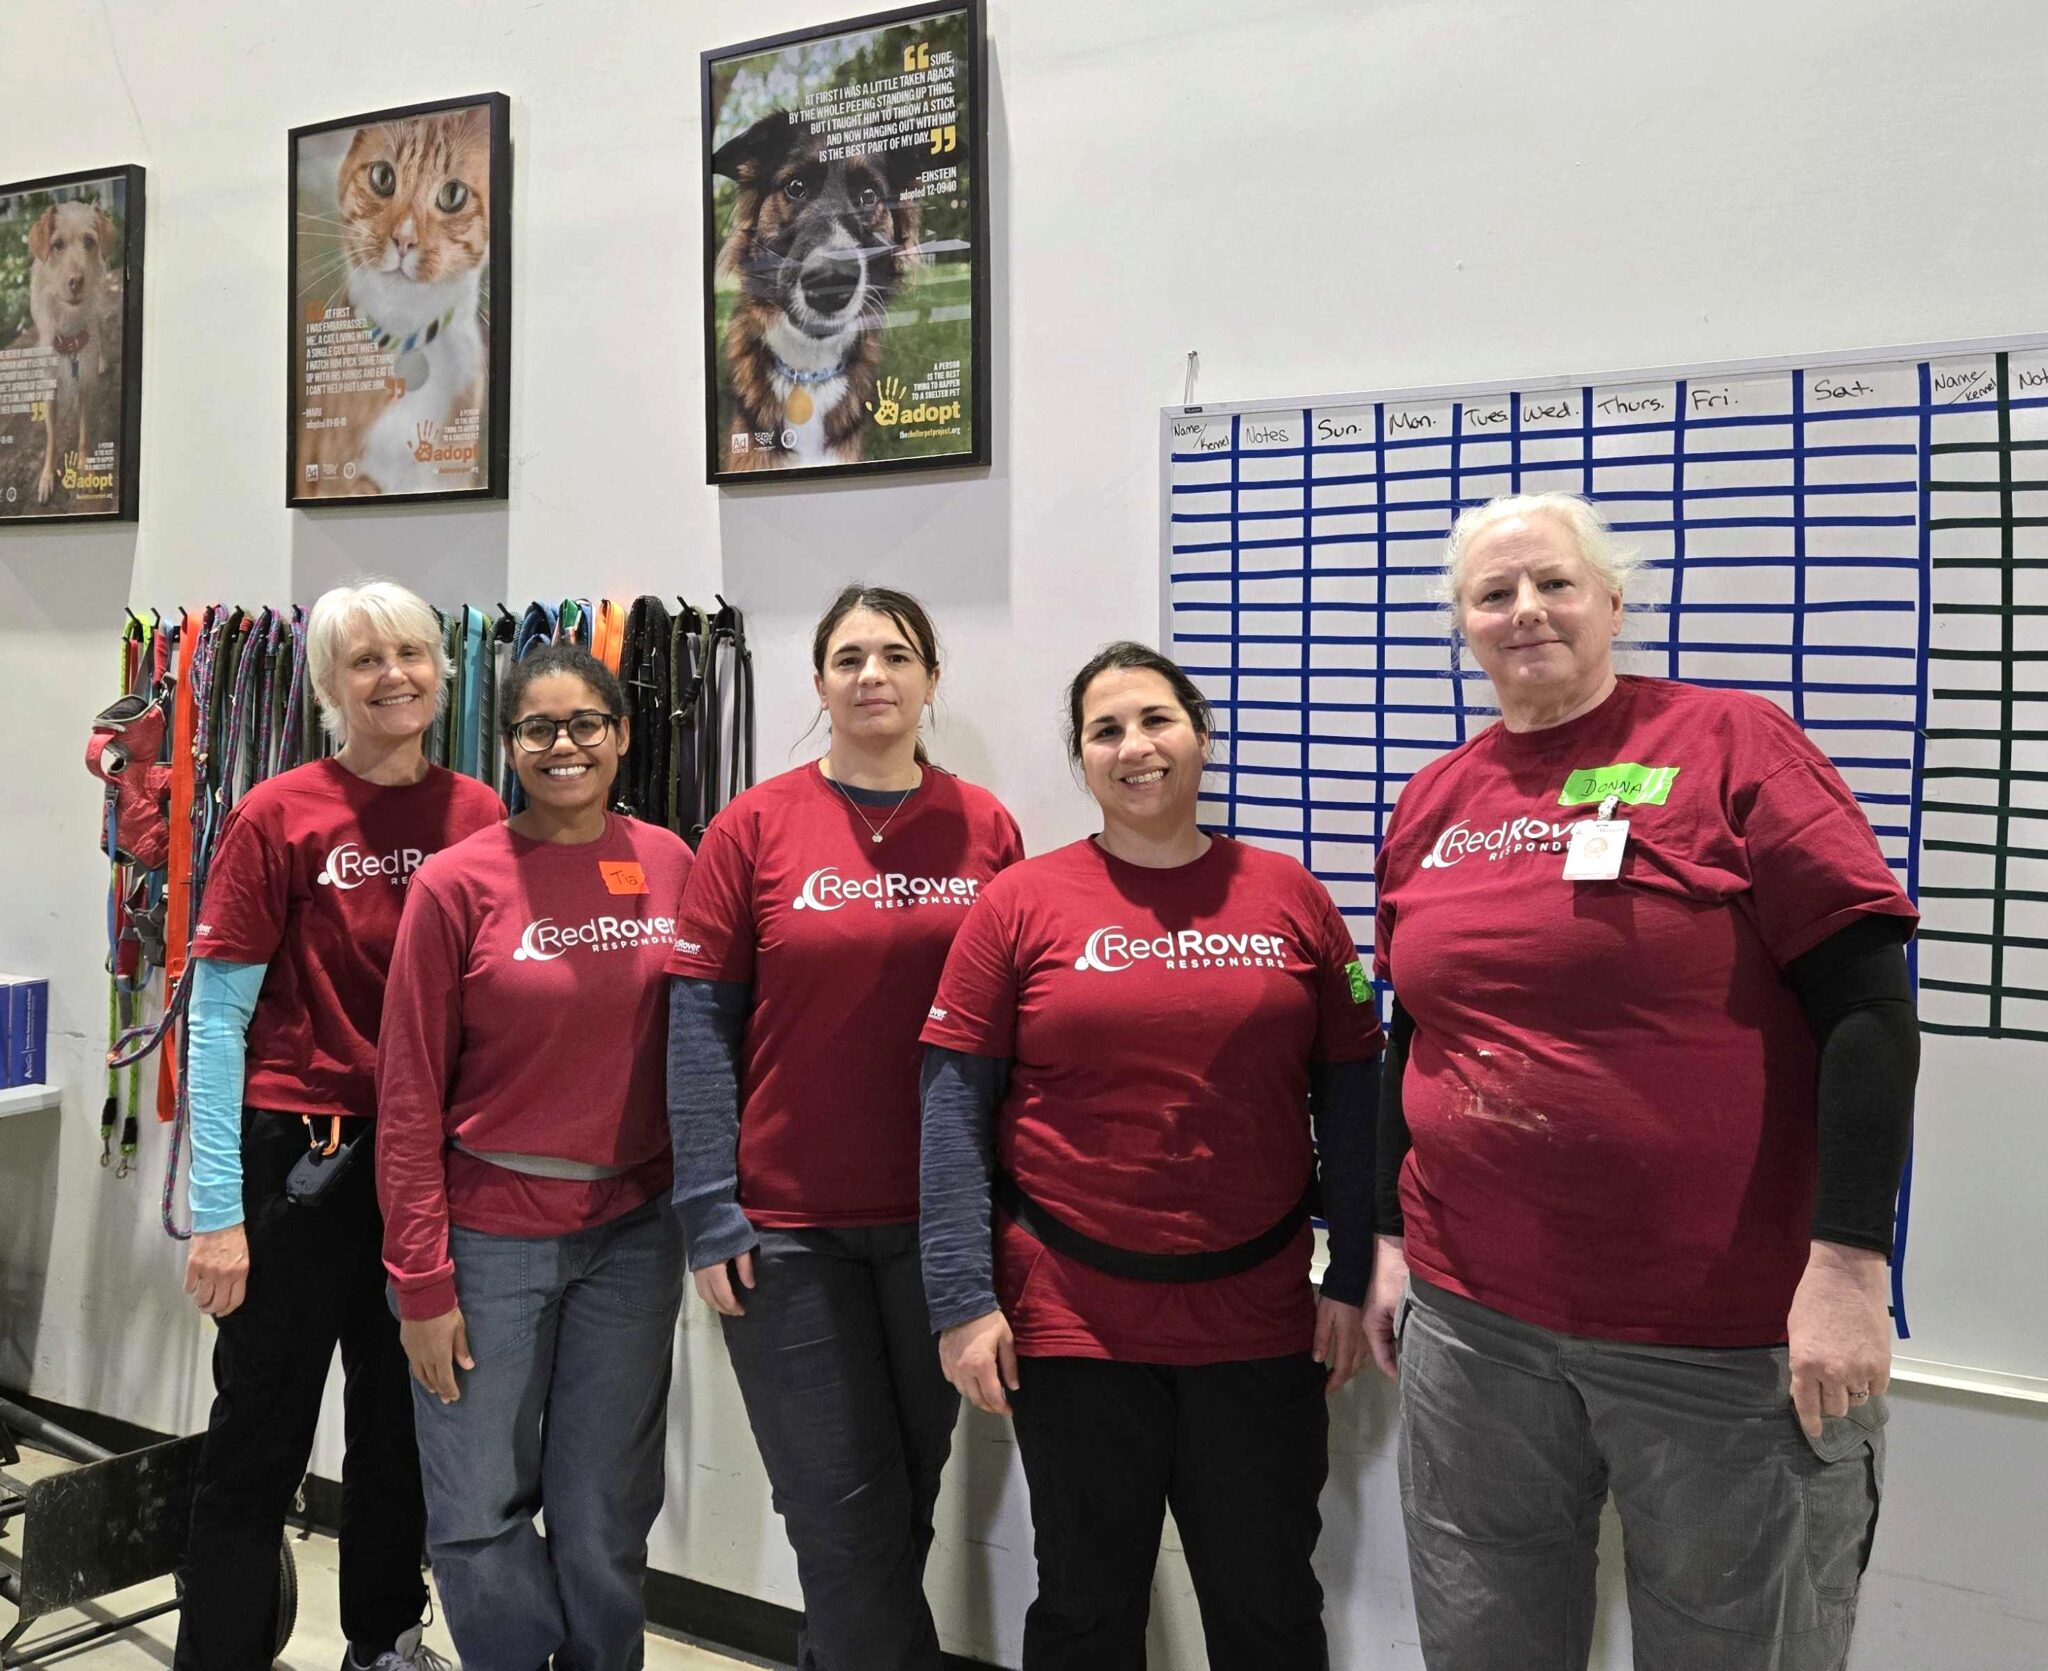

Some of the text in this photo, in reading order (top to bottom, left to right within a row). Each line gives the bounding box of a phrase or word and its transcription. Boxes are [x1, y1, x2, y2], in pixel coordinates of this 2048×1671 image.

[930, 50, 955, 67] SURE,
[805, 92, 815, 107] AT
[815, 88, 838, 105] FIRST
[843, 84, 862, 99] WAS
[862, 83, 869, 96] A
[869, 77, 899, 94] LITTLE
[899, 71, 925, 88] TAKEN
[926, 65, 955, 83] ABACK
[788, 81, 956, 125] BY THE WHOLE PEEING STANDING UP THING.
[810, 95, 956, 135] BUT I TAUGHT HIM TO THROW A STICK
[826, 110, 956, 147] AND NOW HANGING OUT WITH HIM
[819, 130, 930, 163] IS THE BEST PART OF MY DAY.
[899, 184, 926, 201] adopted
[332, 306, 350, 319] FIRST
[927, 369, 960, 381] IS THE BEST
[938, 360, 960, 370] PERSON
[912, 387, 960, 401] TO A SHELTER PET
[930, 381, 938, 390] TO
[1813, 378, 1875, 401] Sat.
[1597, 394, 1666, 416] Thurs.
[1691, 387, 1739, 411] Fri.
[900, 400, 960, 425] adopt
[1522, 401, 1580, 423] Wed.
[1317, 418, 1363, 441] Sun.
[1388, 411, 1437, 436] Mon.
[1245, 425, 1289, 445] Notes
[433, 442, 479, 464] adopt
[76, 472, 114, 491] adopt
[1580, 777, 1643, 798] DONNA
[609, 869, 639, 887] Tia
[819, 872, 979, 901] RedRover
[537, 915, 676, 952] RedRover
[1103, 929, 1286, 961] RedRover
[1166, 956, 1286, 970] RESPONDERS
